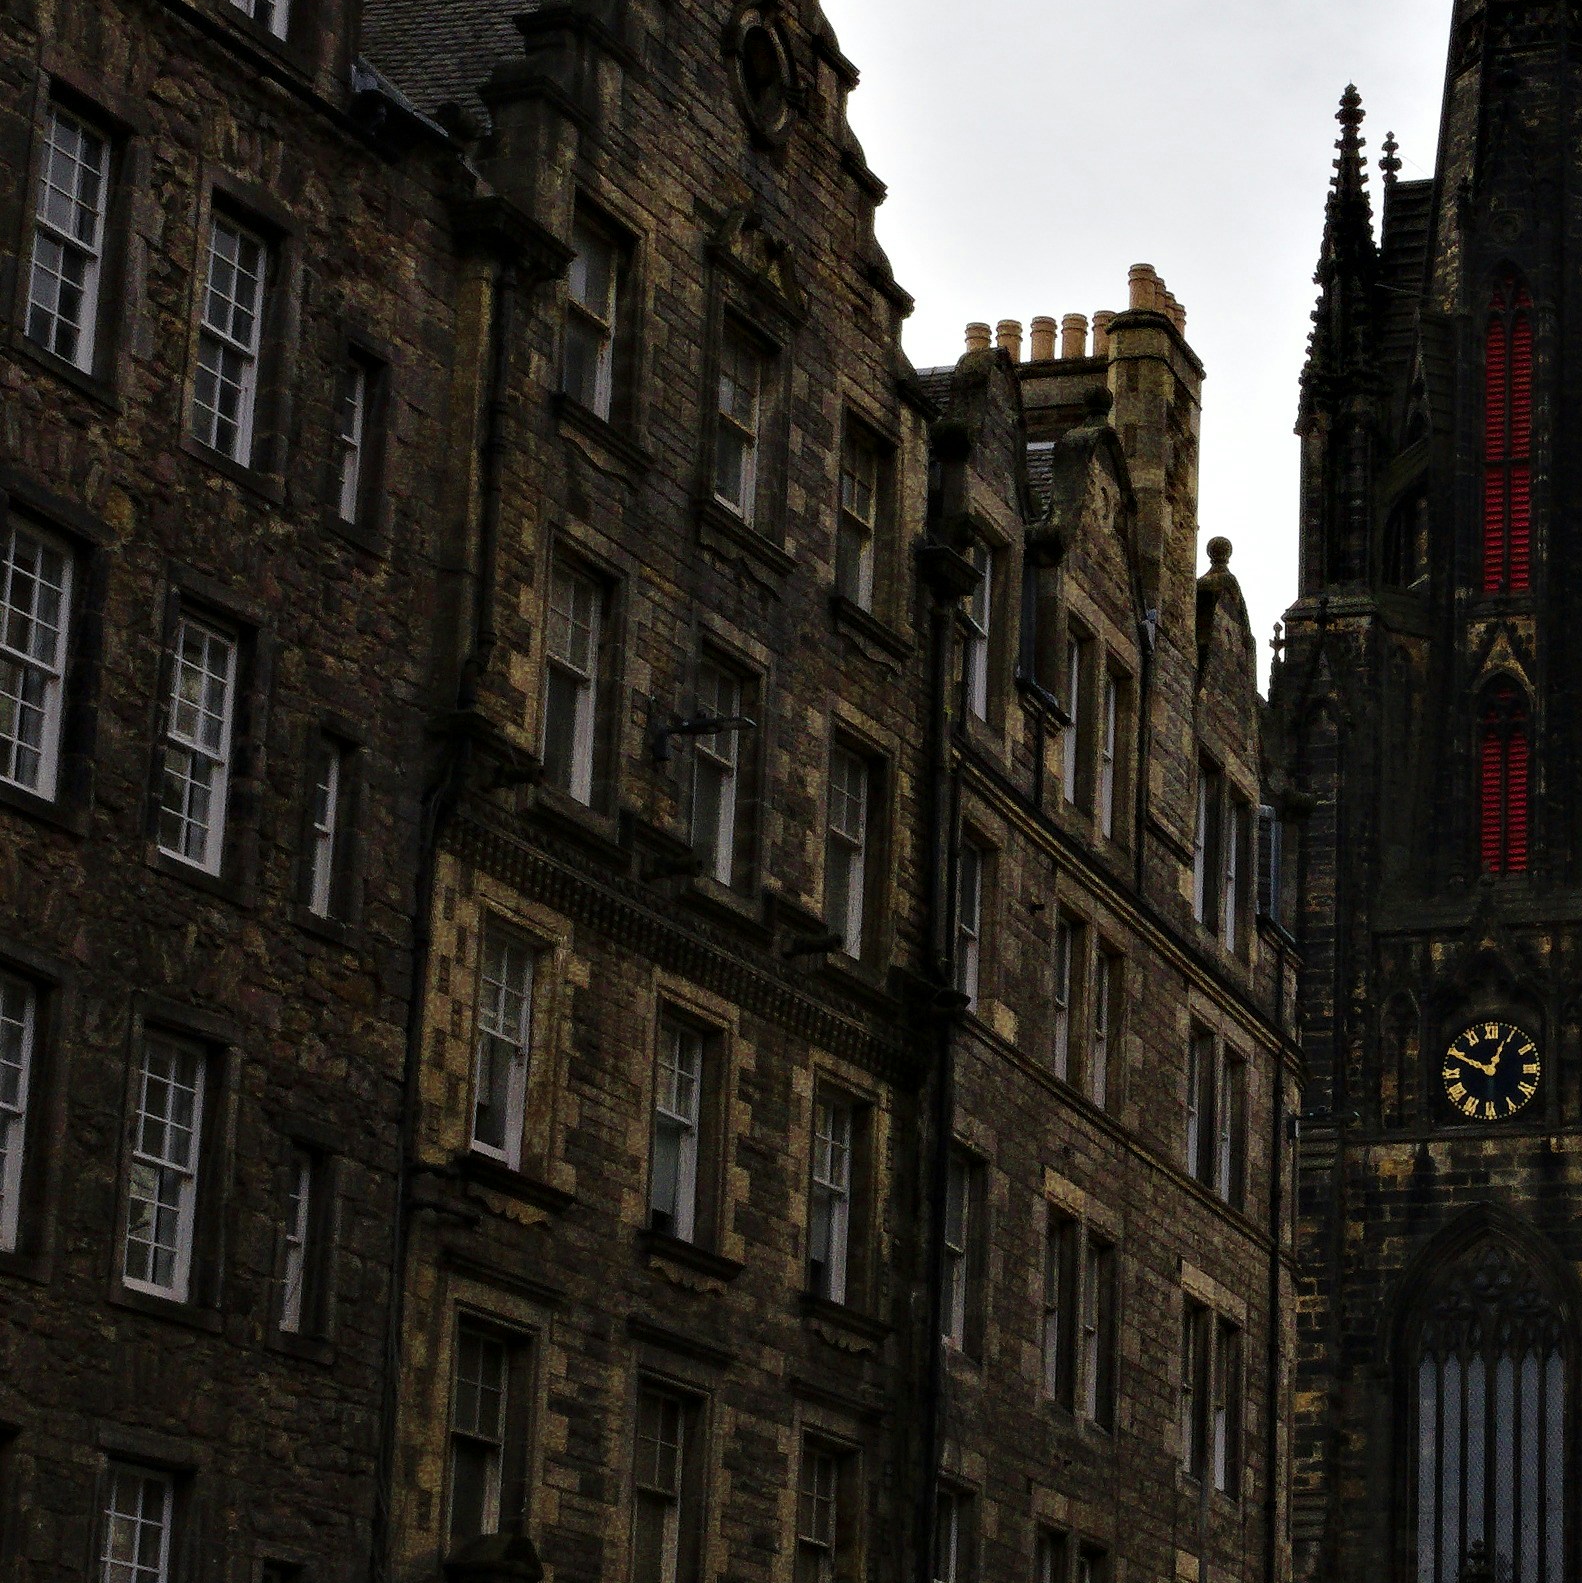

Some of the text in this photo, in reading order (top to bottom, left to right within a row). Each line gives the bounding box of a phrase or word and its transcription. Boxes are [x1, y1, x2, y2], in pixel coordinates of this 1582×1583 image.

[1462, 1028, 1480, 1047] XI
[1484, 1022, 1499, 1040] XII
[1442, 1068, 1460, 1079] IX
